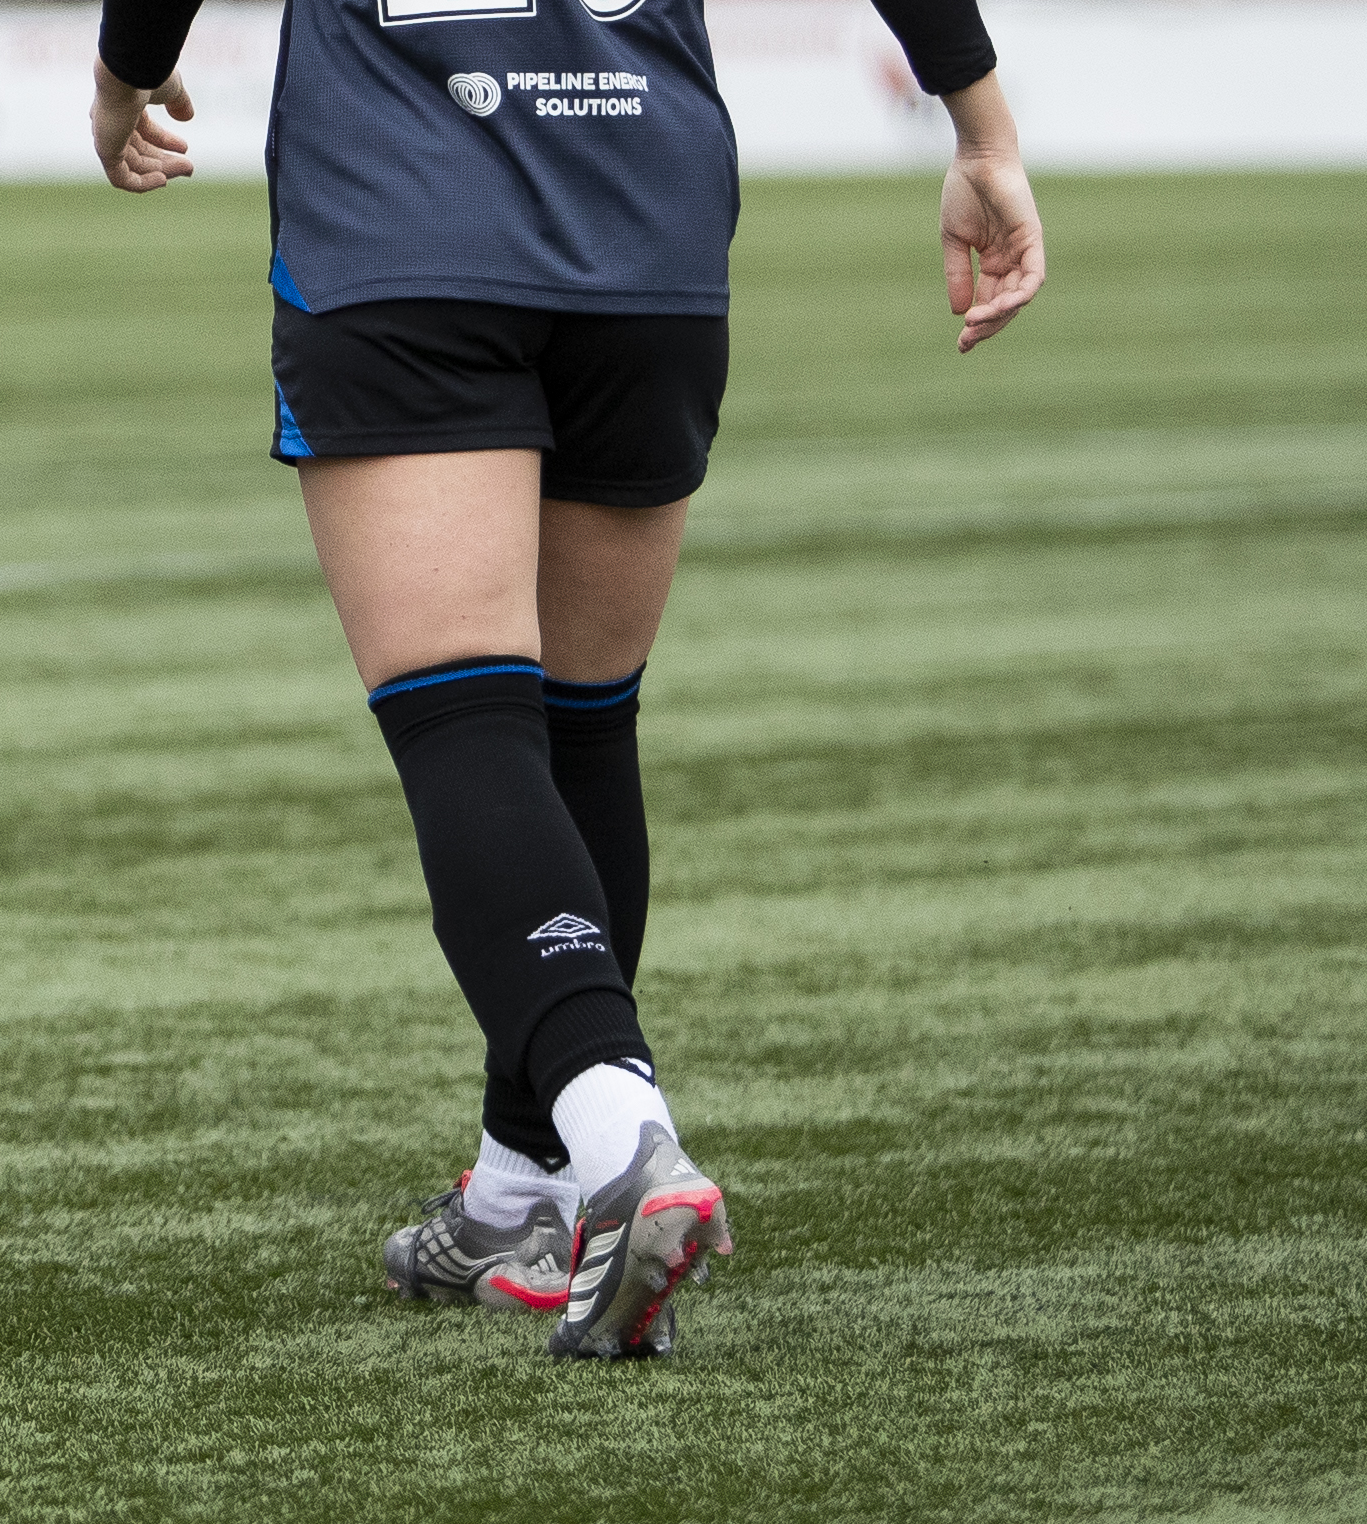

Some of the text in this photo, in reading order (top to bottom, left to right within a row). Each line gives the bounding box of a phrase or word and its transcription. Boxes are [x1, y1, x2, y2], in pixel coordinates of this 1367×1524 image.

[506, 72, 649, 92] PIPELINE ENERGY
[535, 96, 643, 117] SOLUTIONS
[541, 938, 606, 958] umbro
